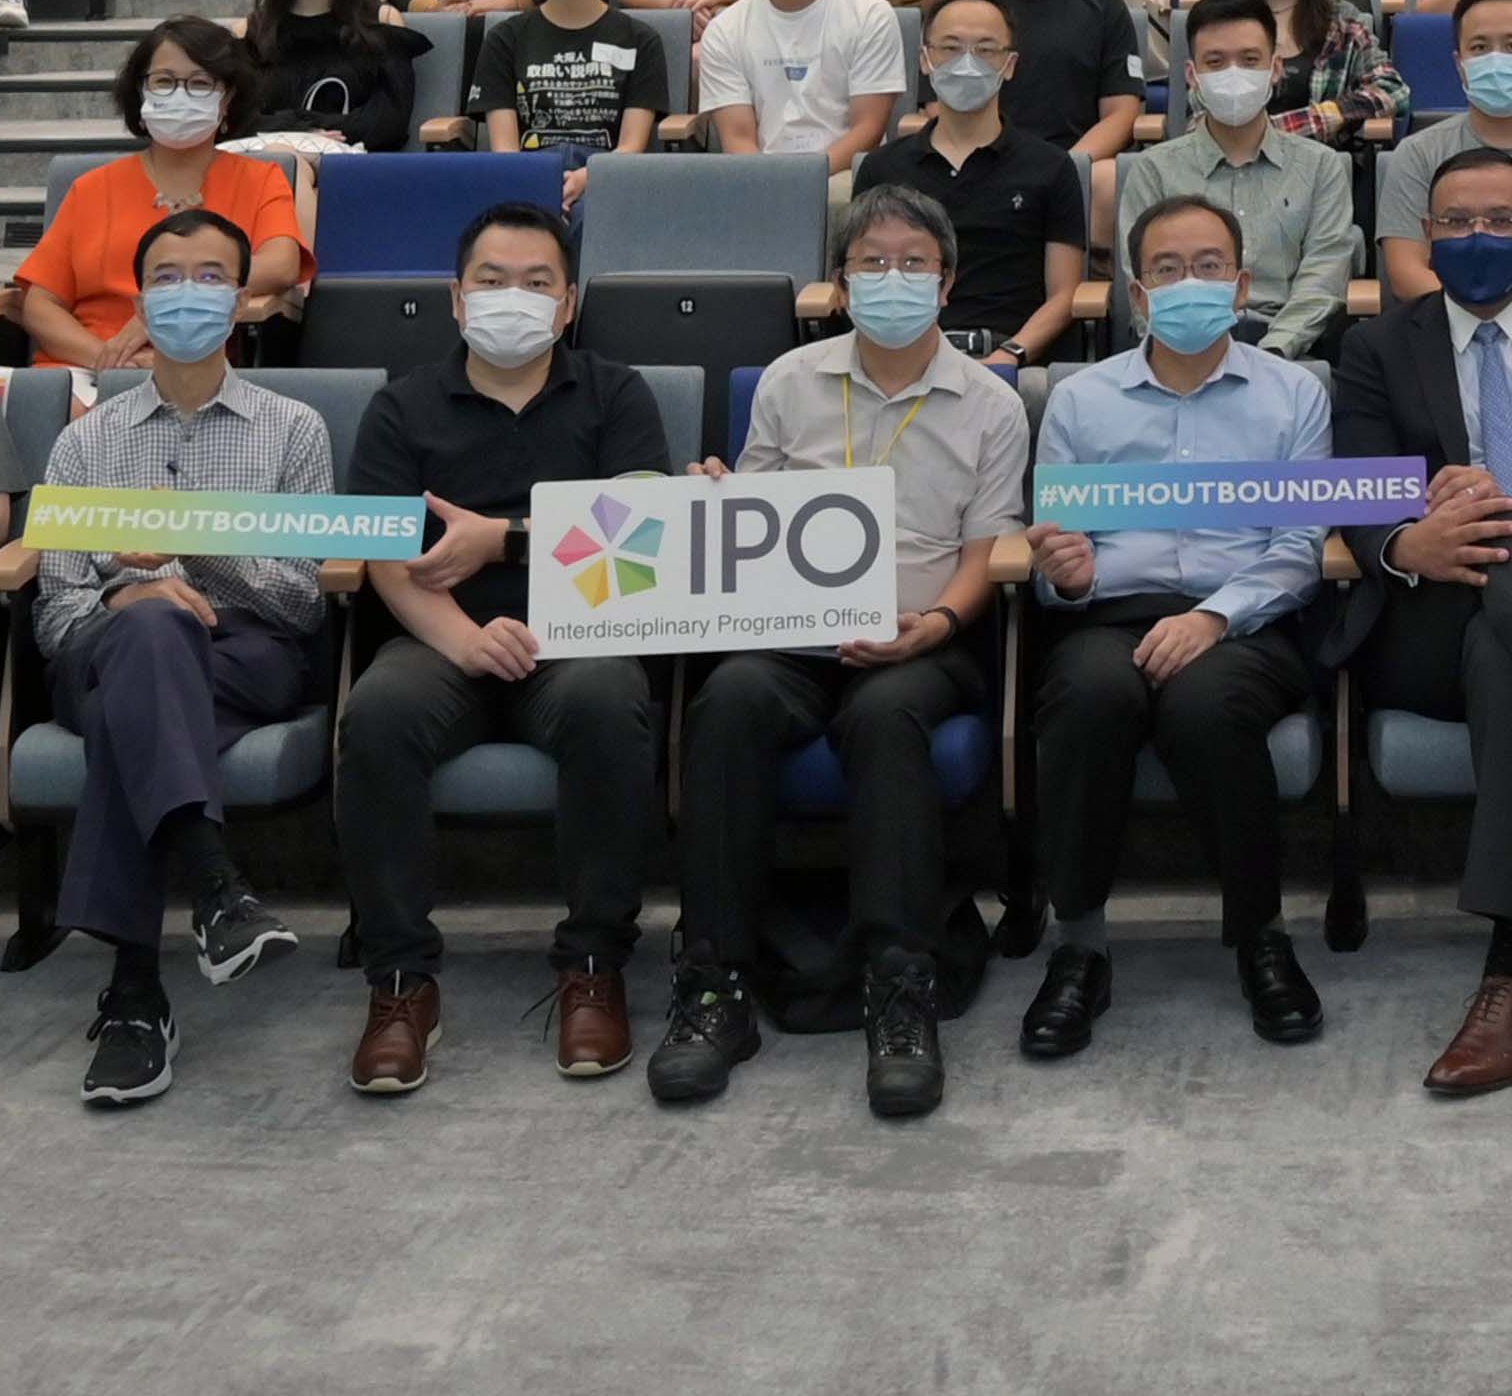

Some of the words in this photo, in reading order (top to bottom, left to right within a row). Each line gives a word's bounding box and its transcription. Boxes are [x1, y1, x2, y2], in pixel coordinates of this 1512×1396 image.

[404, 302, 417, 316] 11
[680, 300, 693, 313] 12
[1039, 477, 1422, 508] #WITHOUTBOUNDARIES
[33, 504, 418, 539] #WITHOUTBOUNDARIES
[690, 493, 881, 595] IPO
[547, 612, 710, 643] Interdisciplinary
[718, 610, 816, 638] Programs
[823, 607, 882, 630] Office
